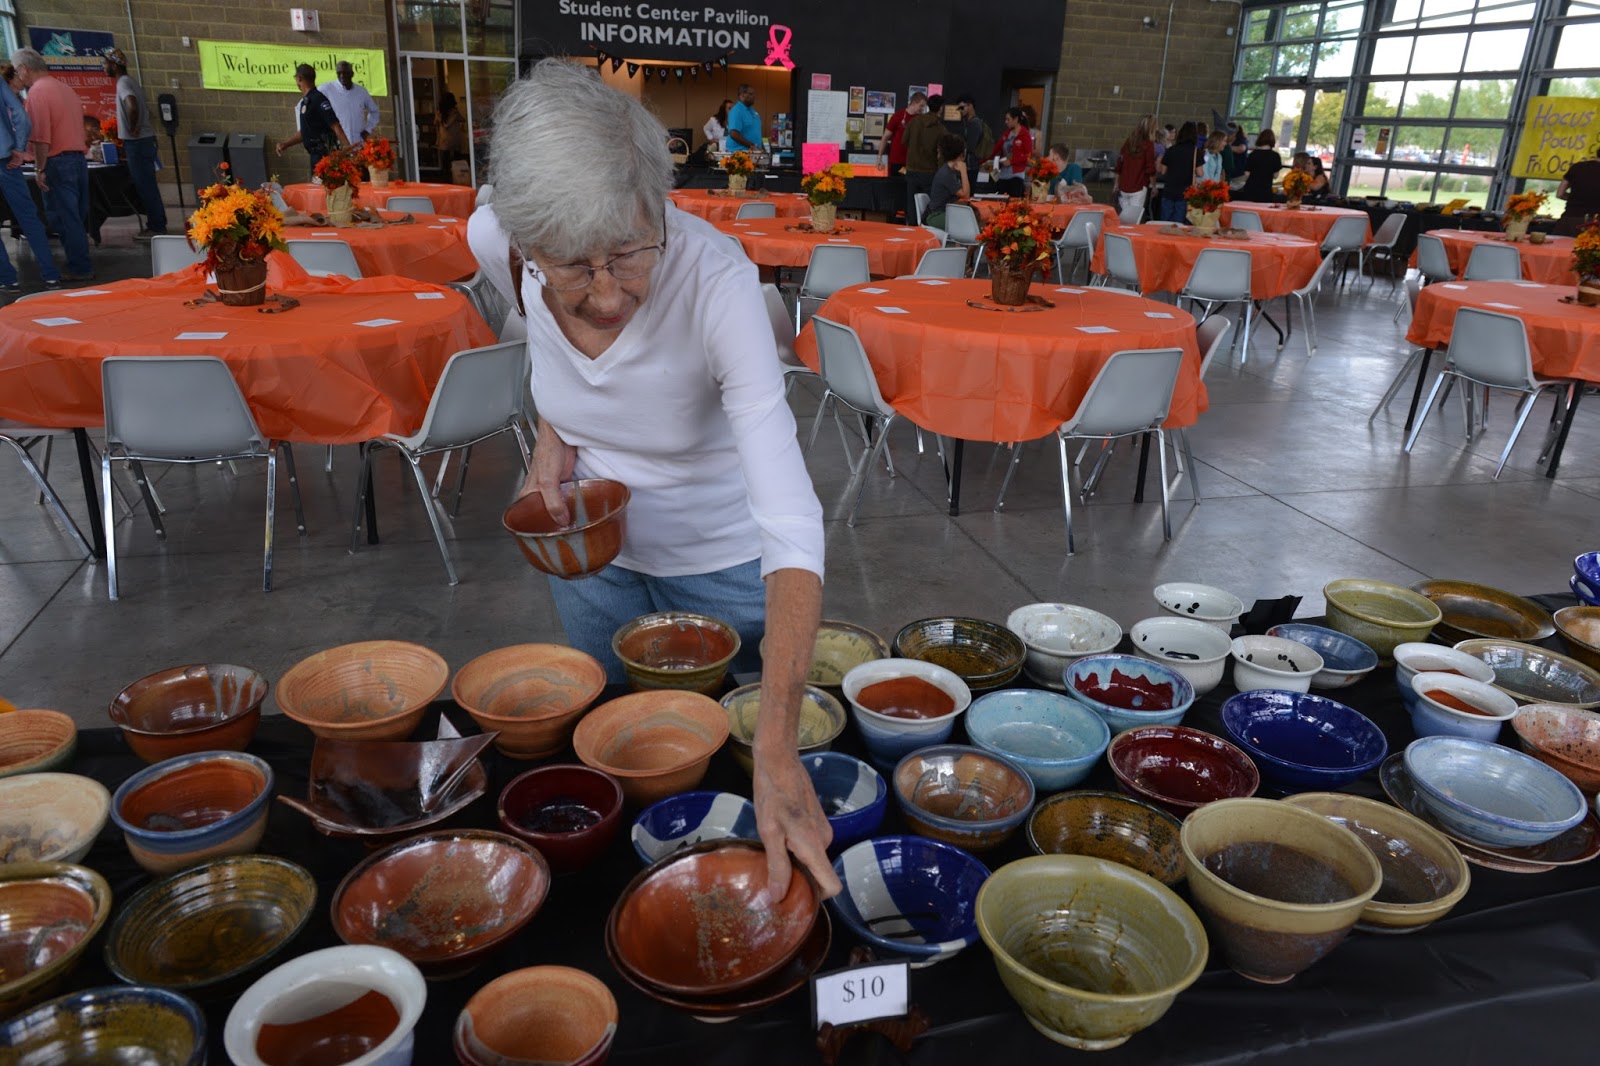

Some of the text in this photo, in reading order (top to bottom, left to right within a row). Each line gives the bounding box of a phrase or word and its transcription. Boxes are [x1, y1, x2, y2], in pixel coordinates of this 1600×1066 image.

[559, 0, 769, 26] Student Center Pavilion
[580, 22, 750, 49] INFORMATION
[221, 53, 289, 75] Welcome
[313, 54, 366, 76] colle!
[599, 52, 726, 77] HALLOWEEN
[842, 975, 885, 1004] $10
